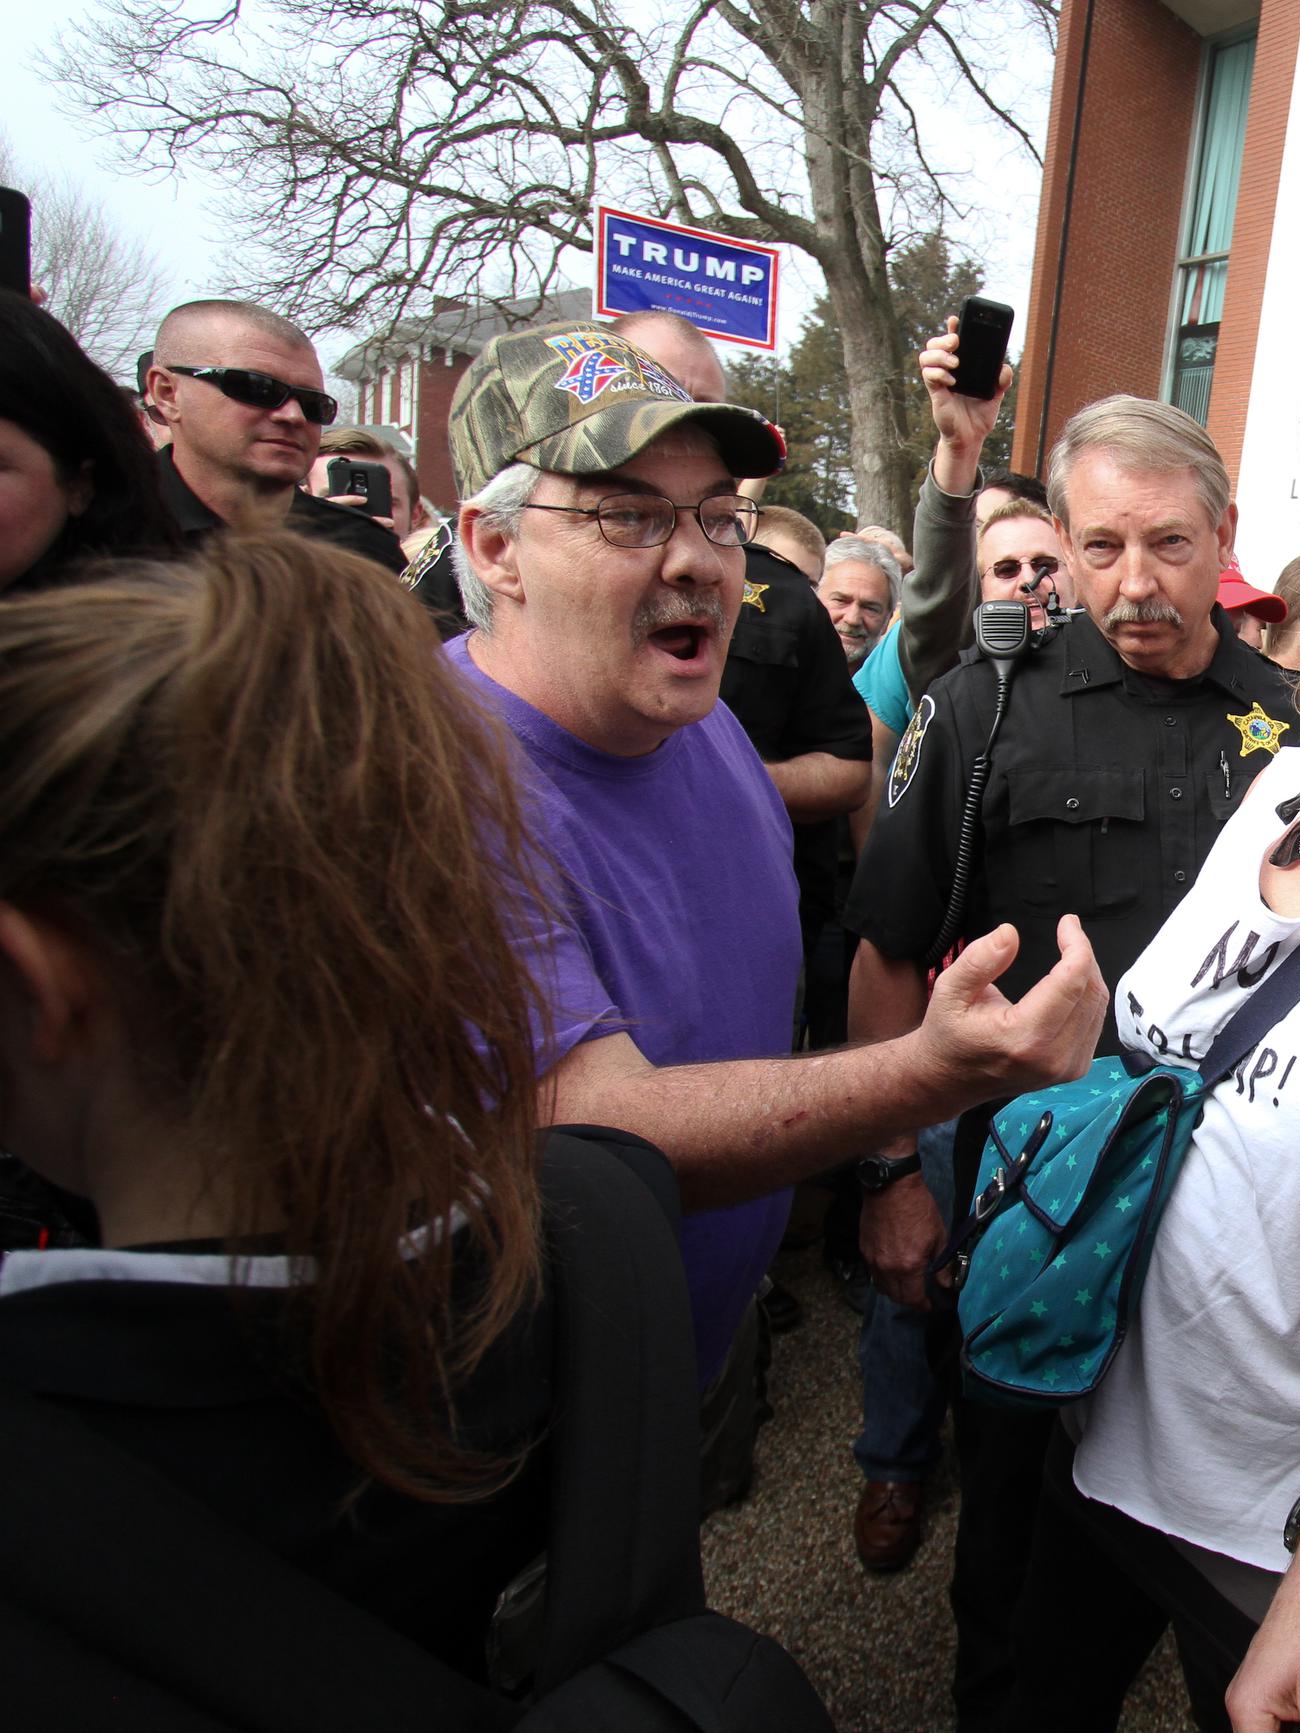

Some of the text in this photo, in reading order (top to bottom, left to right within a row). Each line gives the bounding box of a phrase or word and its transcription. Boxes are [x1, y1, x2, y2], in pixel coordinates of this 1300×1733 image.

[612, 232, 765, 286] TRUMP
[611, 263, 763, 307] MAKE AMERICA GREAT AGAIN!
[609, 381, 675, 398] since 1861
